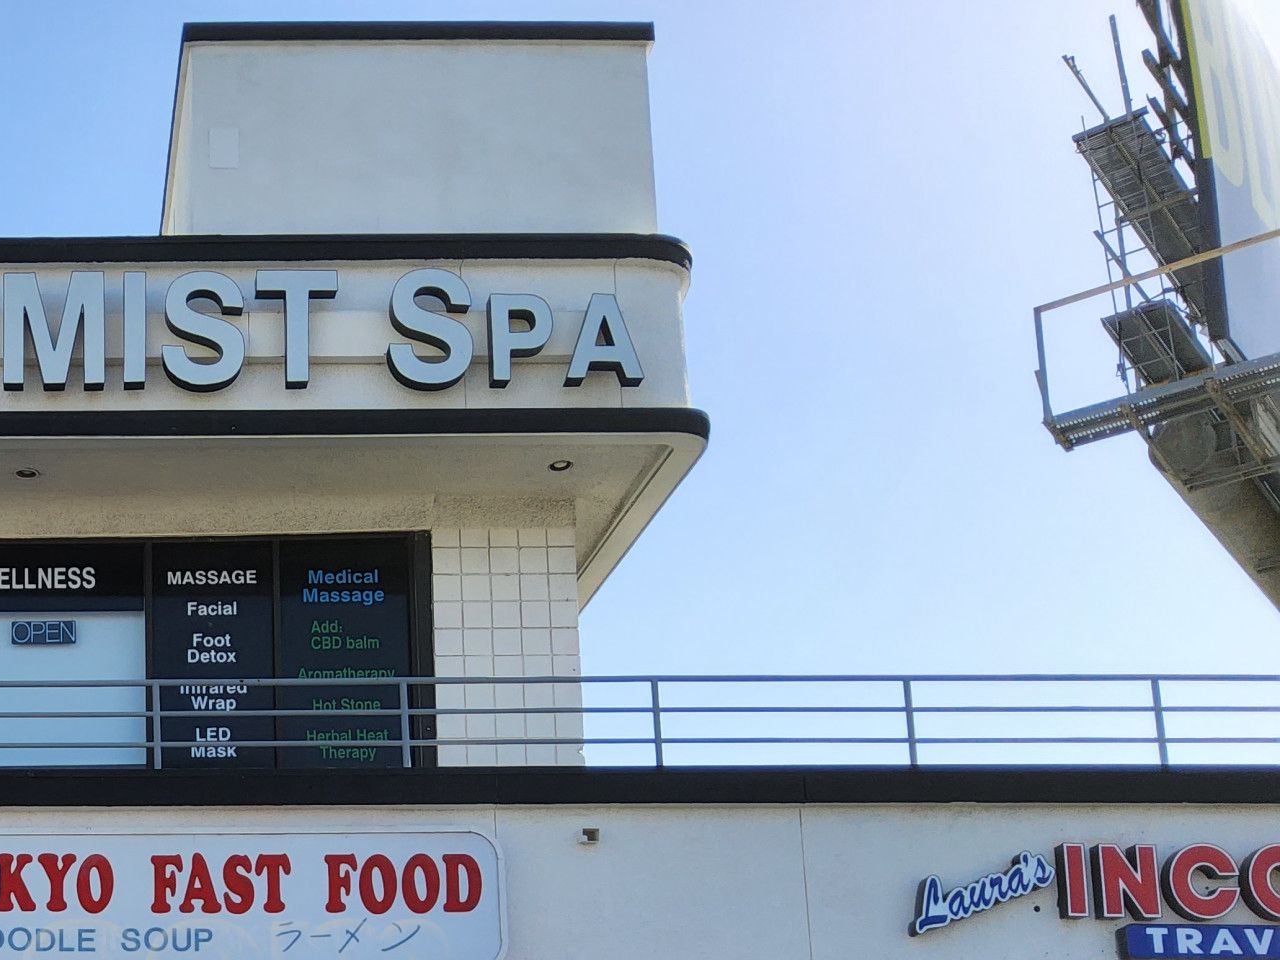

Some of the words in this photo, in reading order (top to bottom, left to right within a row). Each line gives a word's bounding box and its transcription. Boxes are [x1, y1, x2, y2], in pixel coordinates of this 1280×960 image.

[2, 268, 339, 392] MIST
[388, 268, 644, 391] SPA
[167, 570, 257, 585] MASSAGE
[308, 569, 379, 584] Medical
[303, 588, 385, 605] Massage
[187, 601, 237, 616] Facial
[11, 621, 76, 643] OPEN
[311, 620, 343, 634] Add:
[192, 633, 232, 647] Foot
[311, 636, 342, 650] CBD
[346, 636, 380, 649] balm
[187, 650, 237, 663] Detox
[298, 667, 395, 678] Aromatherapy
[191, 696, 237, 711] Wrap
[312, 699, 336, 711] Hot
[340, 698, 381, 711] Stone
[195, 727, 231, 741] LED
[306, 728, 351, 741] Herbal
[356, 728, 389, 741] Heat
[190, 746, 238, 758] Mask
[320, 746, 377, 762] Therapy
[150, 852, 291, 914] FAST
[324, 853, 483, 915] FOOD
[912, 850, 1055, 935] Laura's
[121, 926, 212, 953] SOUP
[275, 917, 422, 954] ラーメン
[1145, 927, 1276, 955] TRAV
